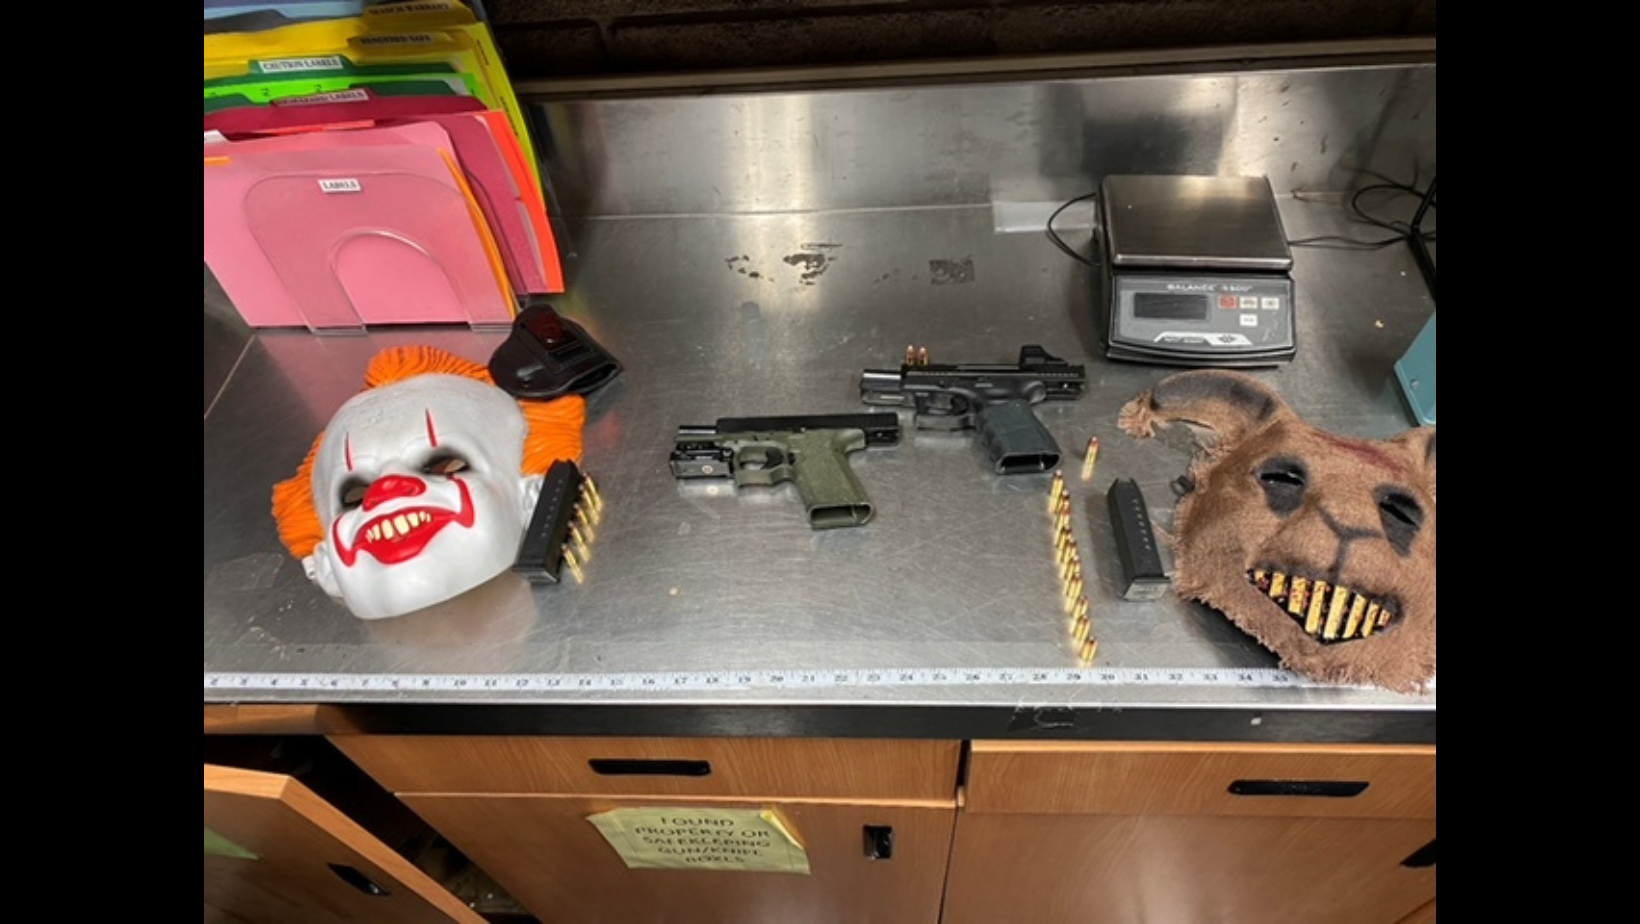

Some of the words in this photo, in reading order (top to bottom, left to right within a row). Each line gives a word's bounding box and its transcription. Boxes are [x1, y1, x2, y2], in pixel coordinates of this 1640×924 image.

[263, 59, 304, 70] CAUTION
[305, 57, 340, 68] LABELS
[329, 91, 365, 101] LABELS
[323, 180, 357, 189] LABELS
[660, 816, 734, 827] FOUND
[634, 826, 735, 838] PROPERTY
[741, 829, 771, 838] OR
